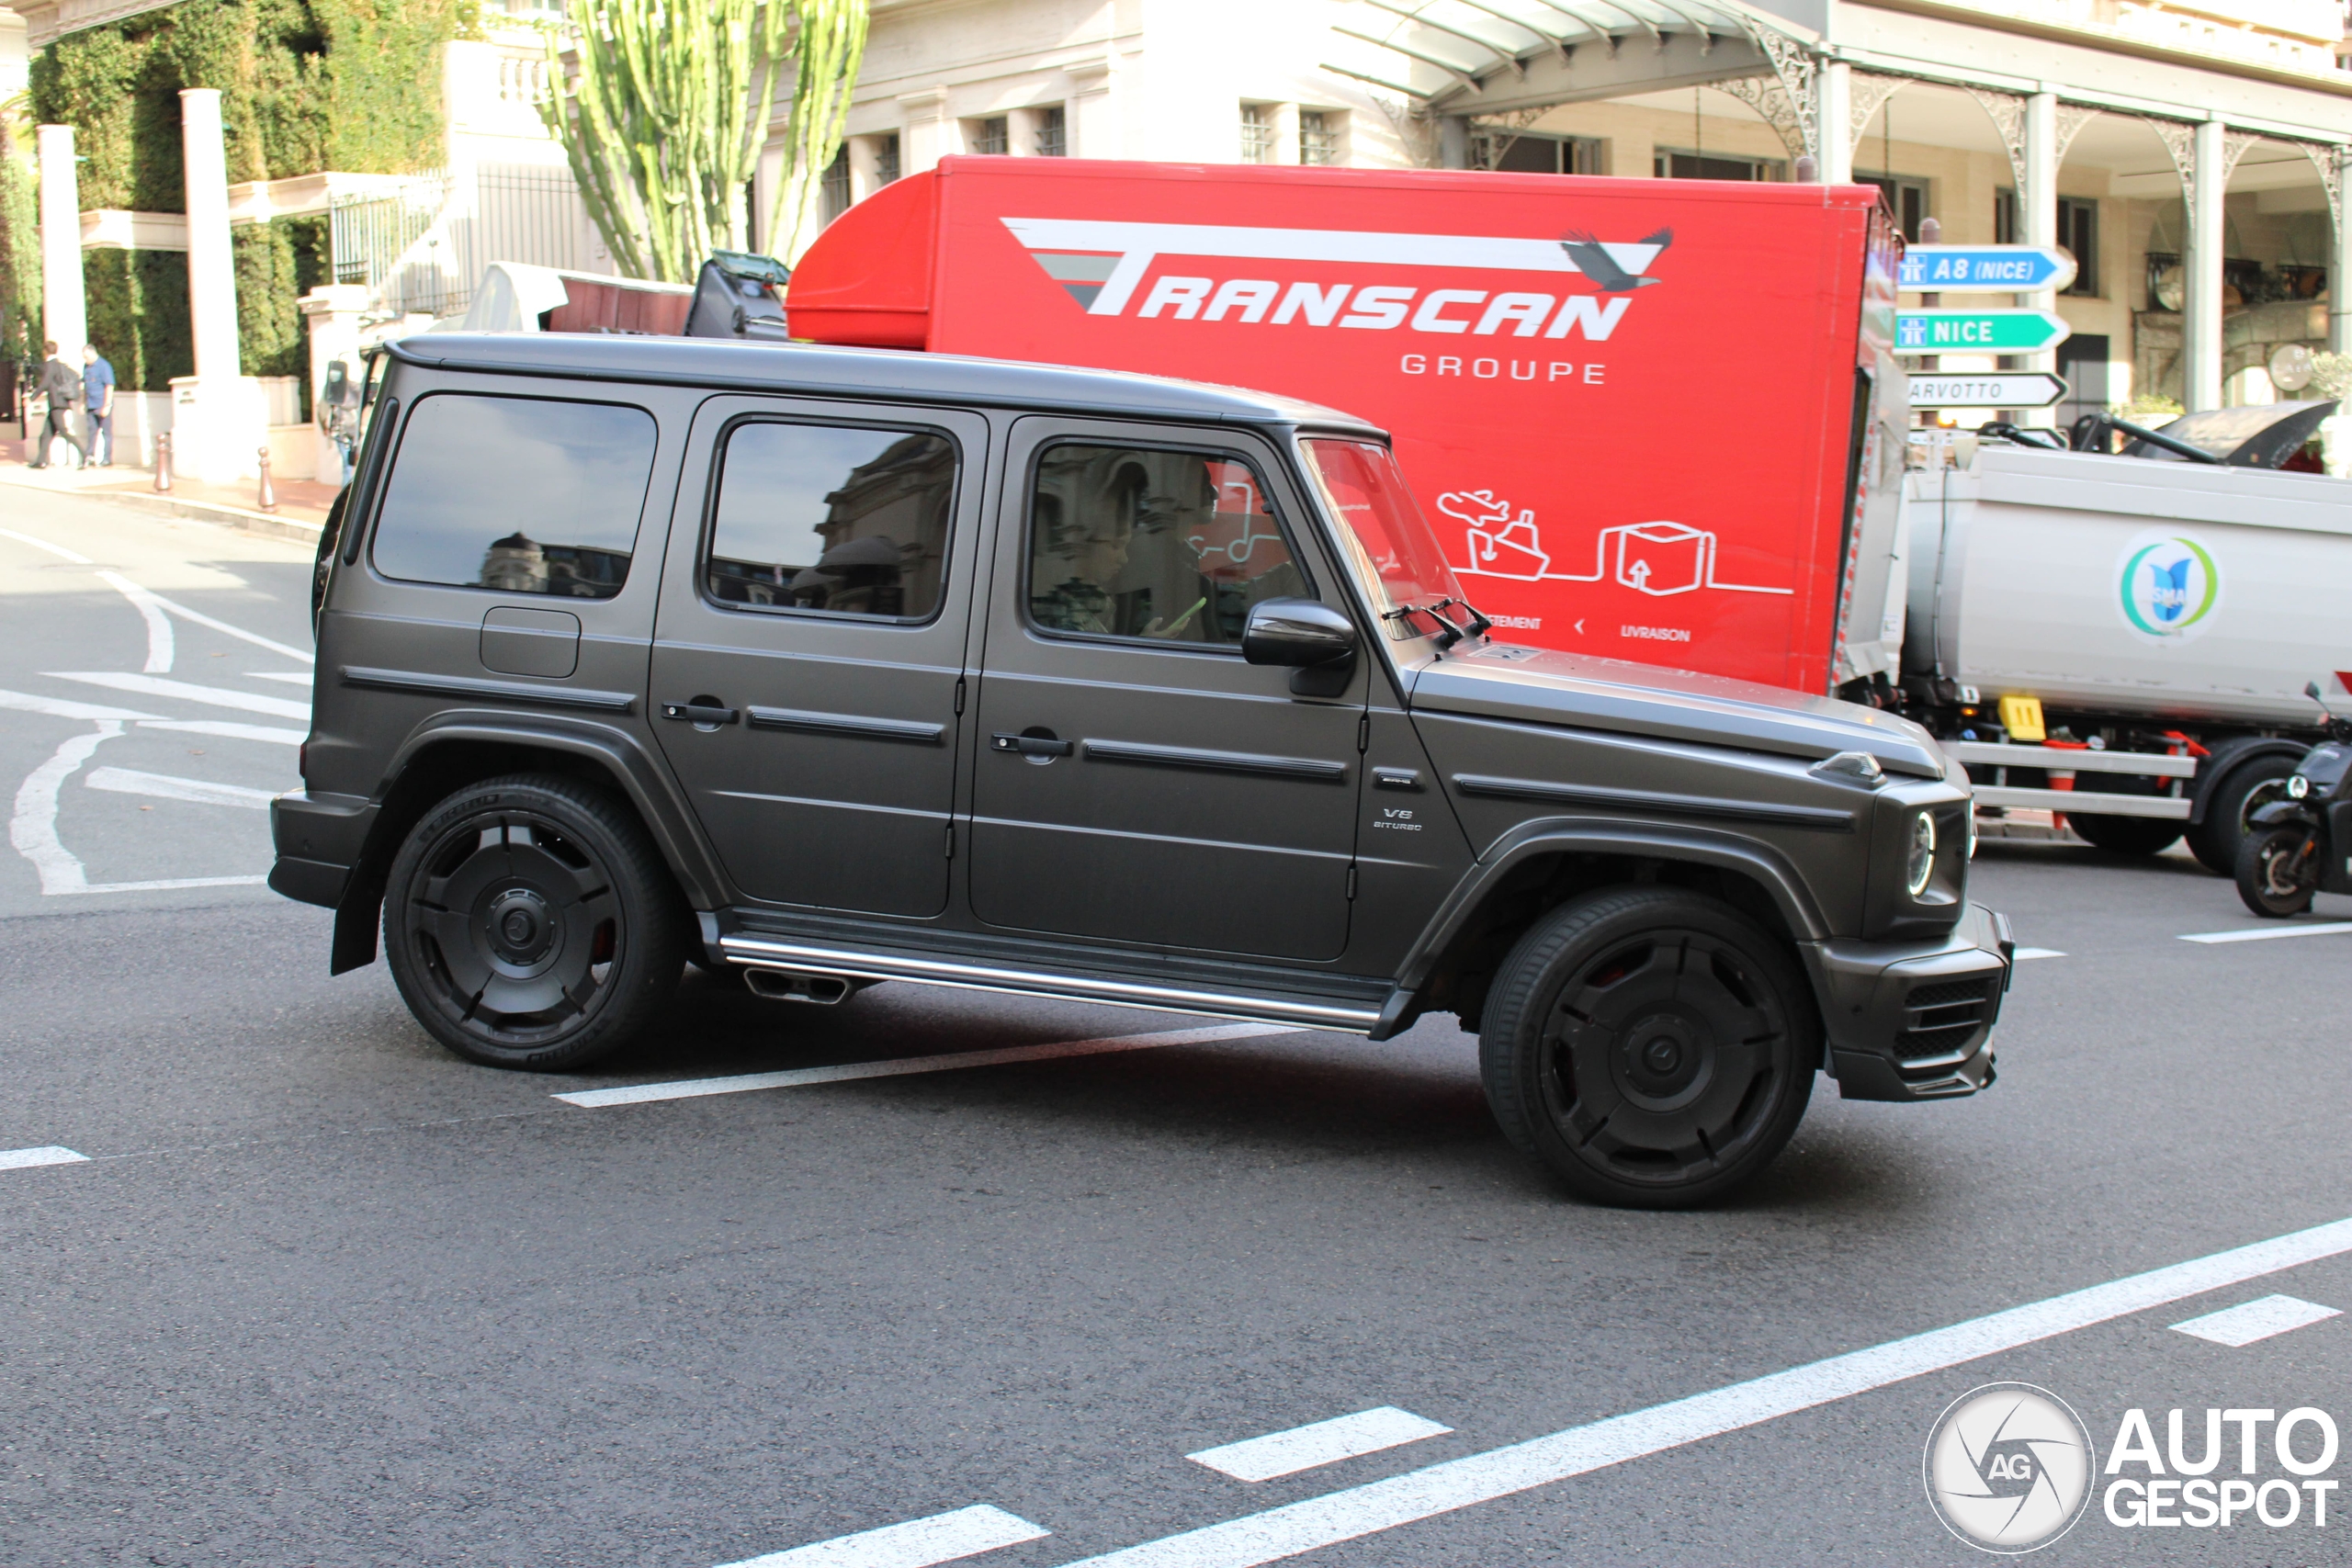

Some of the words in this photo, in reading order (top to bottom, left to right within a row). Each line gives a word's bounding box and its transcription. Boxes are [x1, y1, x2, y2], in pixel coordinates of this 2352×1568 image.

[1934, 258, 1969, 280] A8
[1974, 260, 2034, 281] (NICE)
[1000, 217, 1664, 342] TRANSCAN
[1934, 321, 1994, 343] NICE
[1400, 354, 1606, 385] GROUPE
[1910, 383, 2002, 398] ARVOTTO
[1486, 614, 1542, 630] ETEMENT
[1621, 625, 1690, 642] LIVRAISON
[1384, 808, 1413, 819] V8
[1374, 821, 1422, 831] BITURBO
